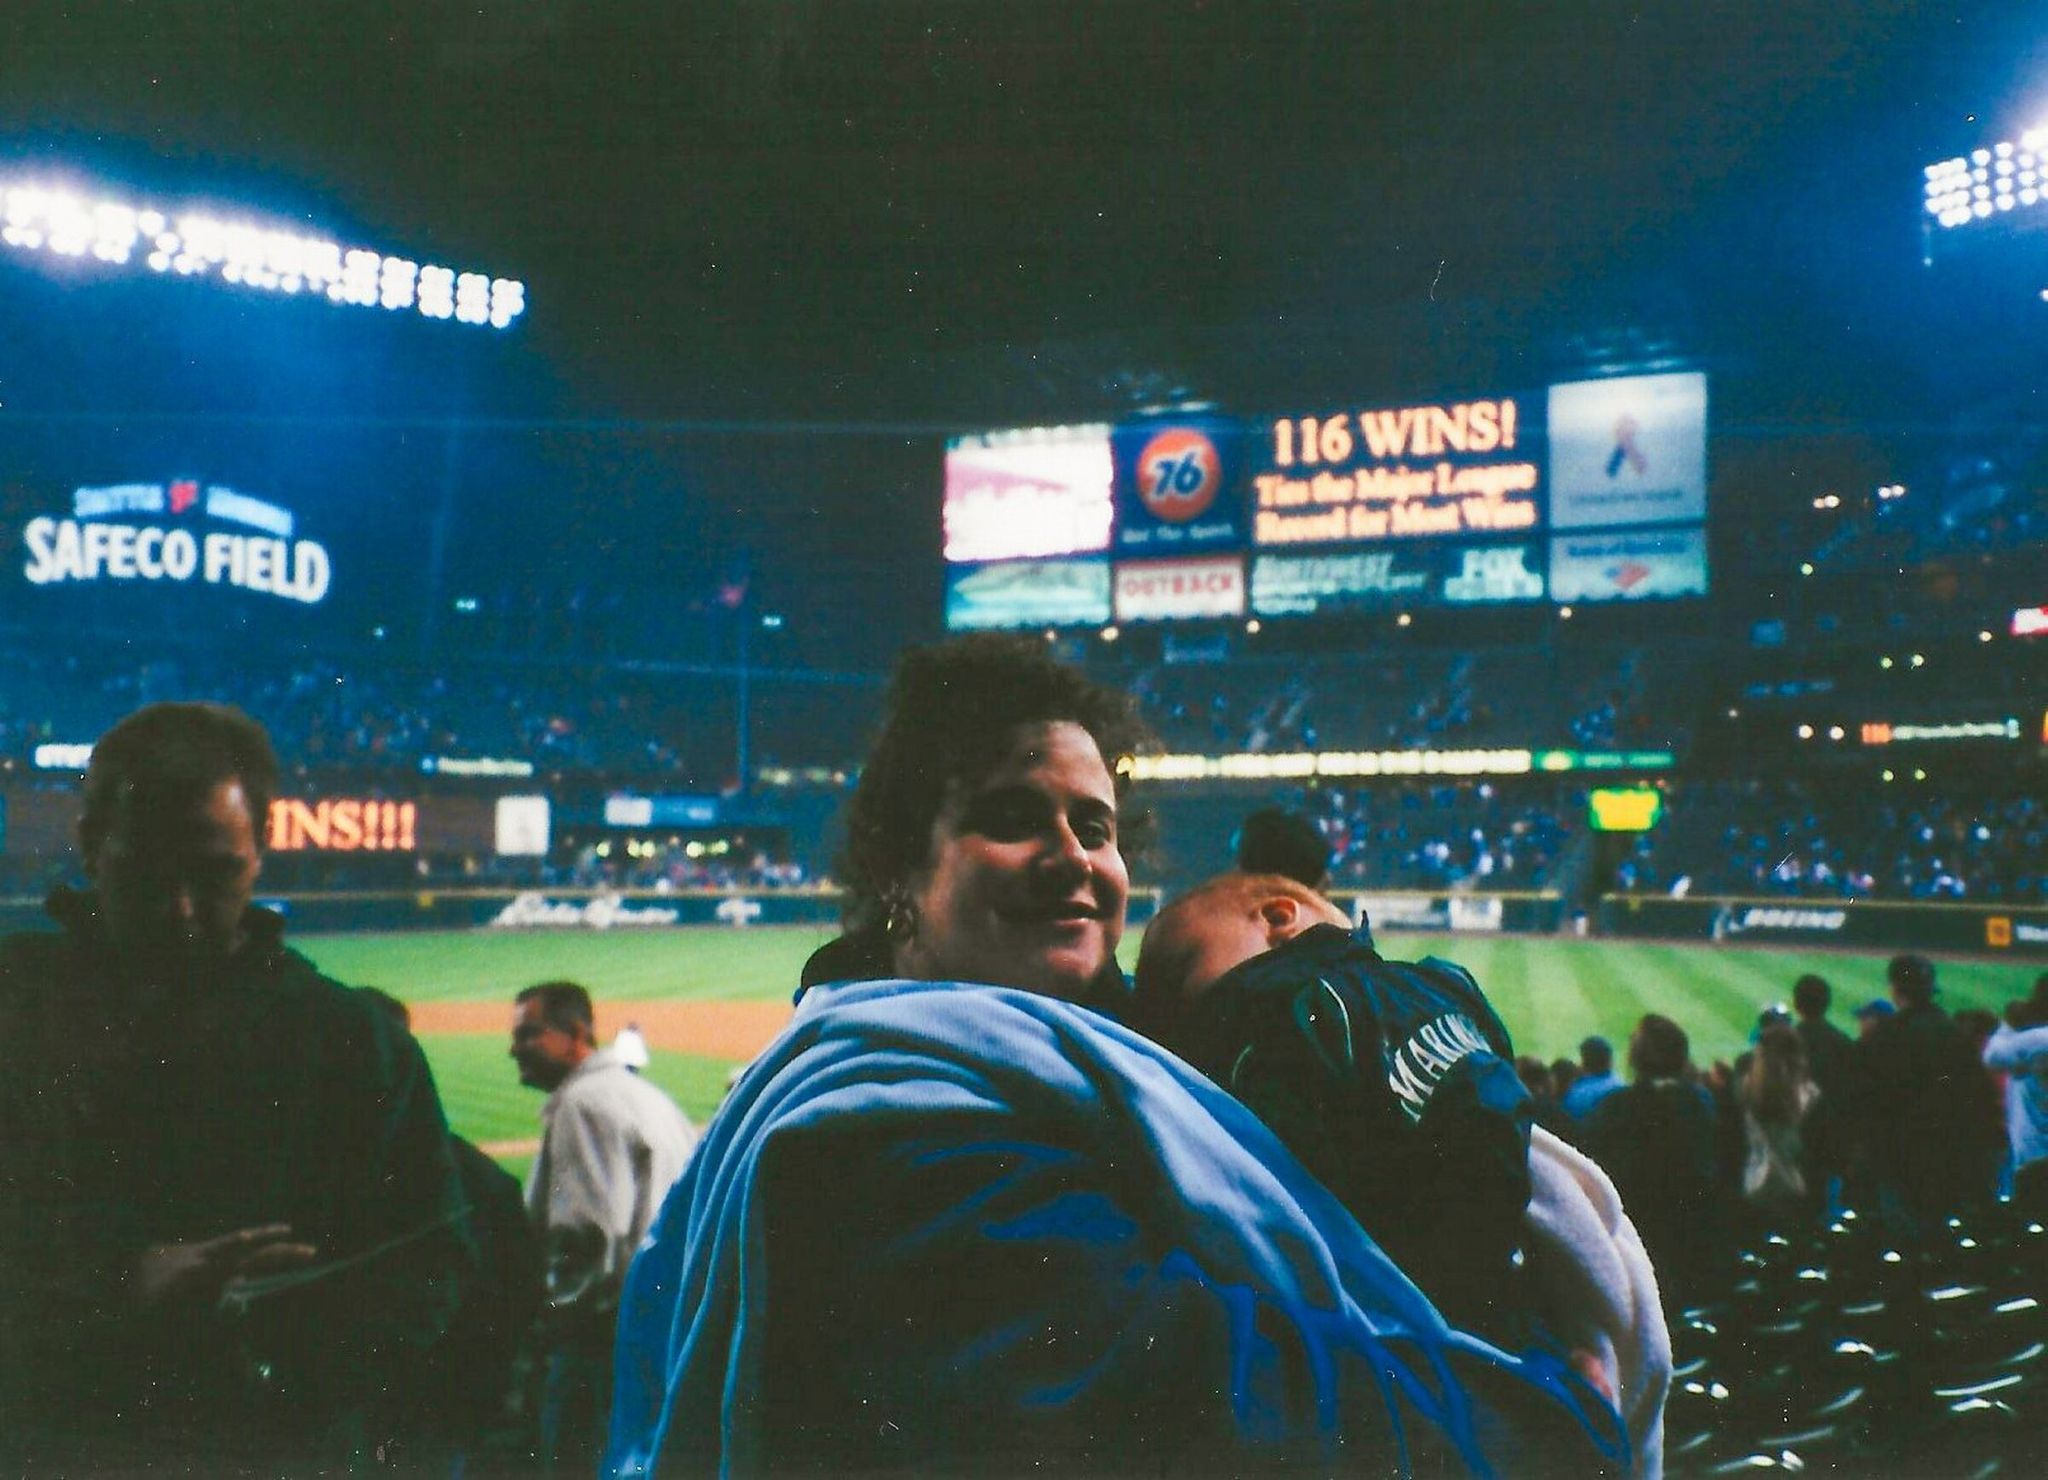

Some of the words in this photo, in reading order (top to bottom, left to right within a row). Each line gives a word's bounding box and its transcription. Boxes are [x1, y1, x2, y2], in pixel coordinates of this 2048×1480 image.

[1273, 415, 1354, 467] 116
[1359, 398, 1518, 459] WINS!
[1154, 450, 1205, 497] 76
[24, 517, 197, 584] SAFECO
[204, 532, 331, 604] FIELD
[1124, 572, 1234, 598] OUTBACK
[268, 799, 416, 850] INS!!!
